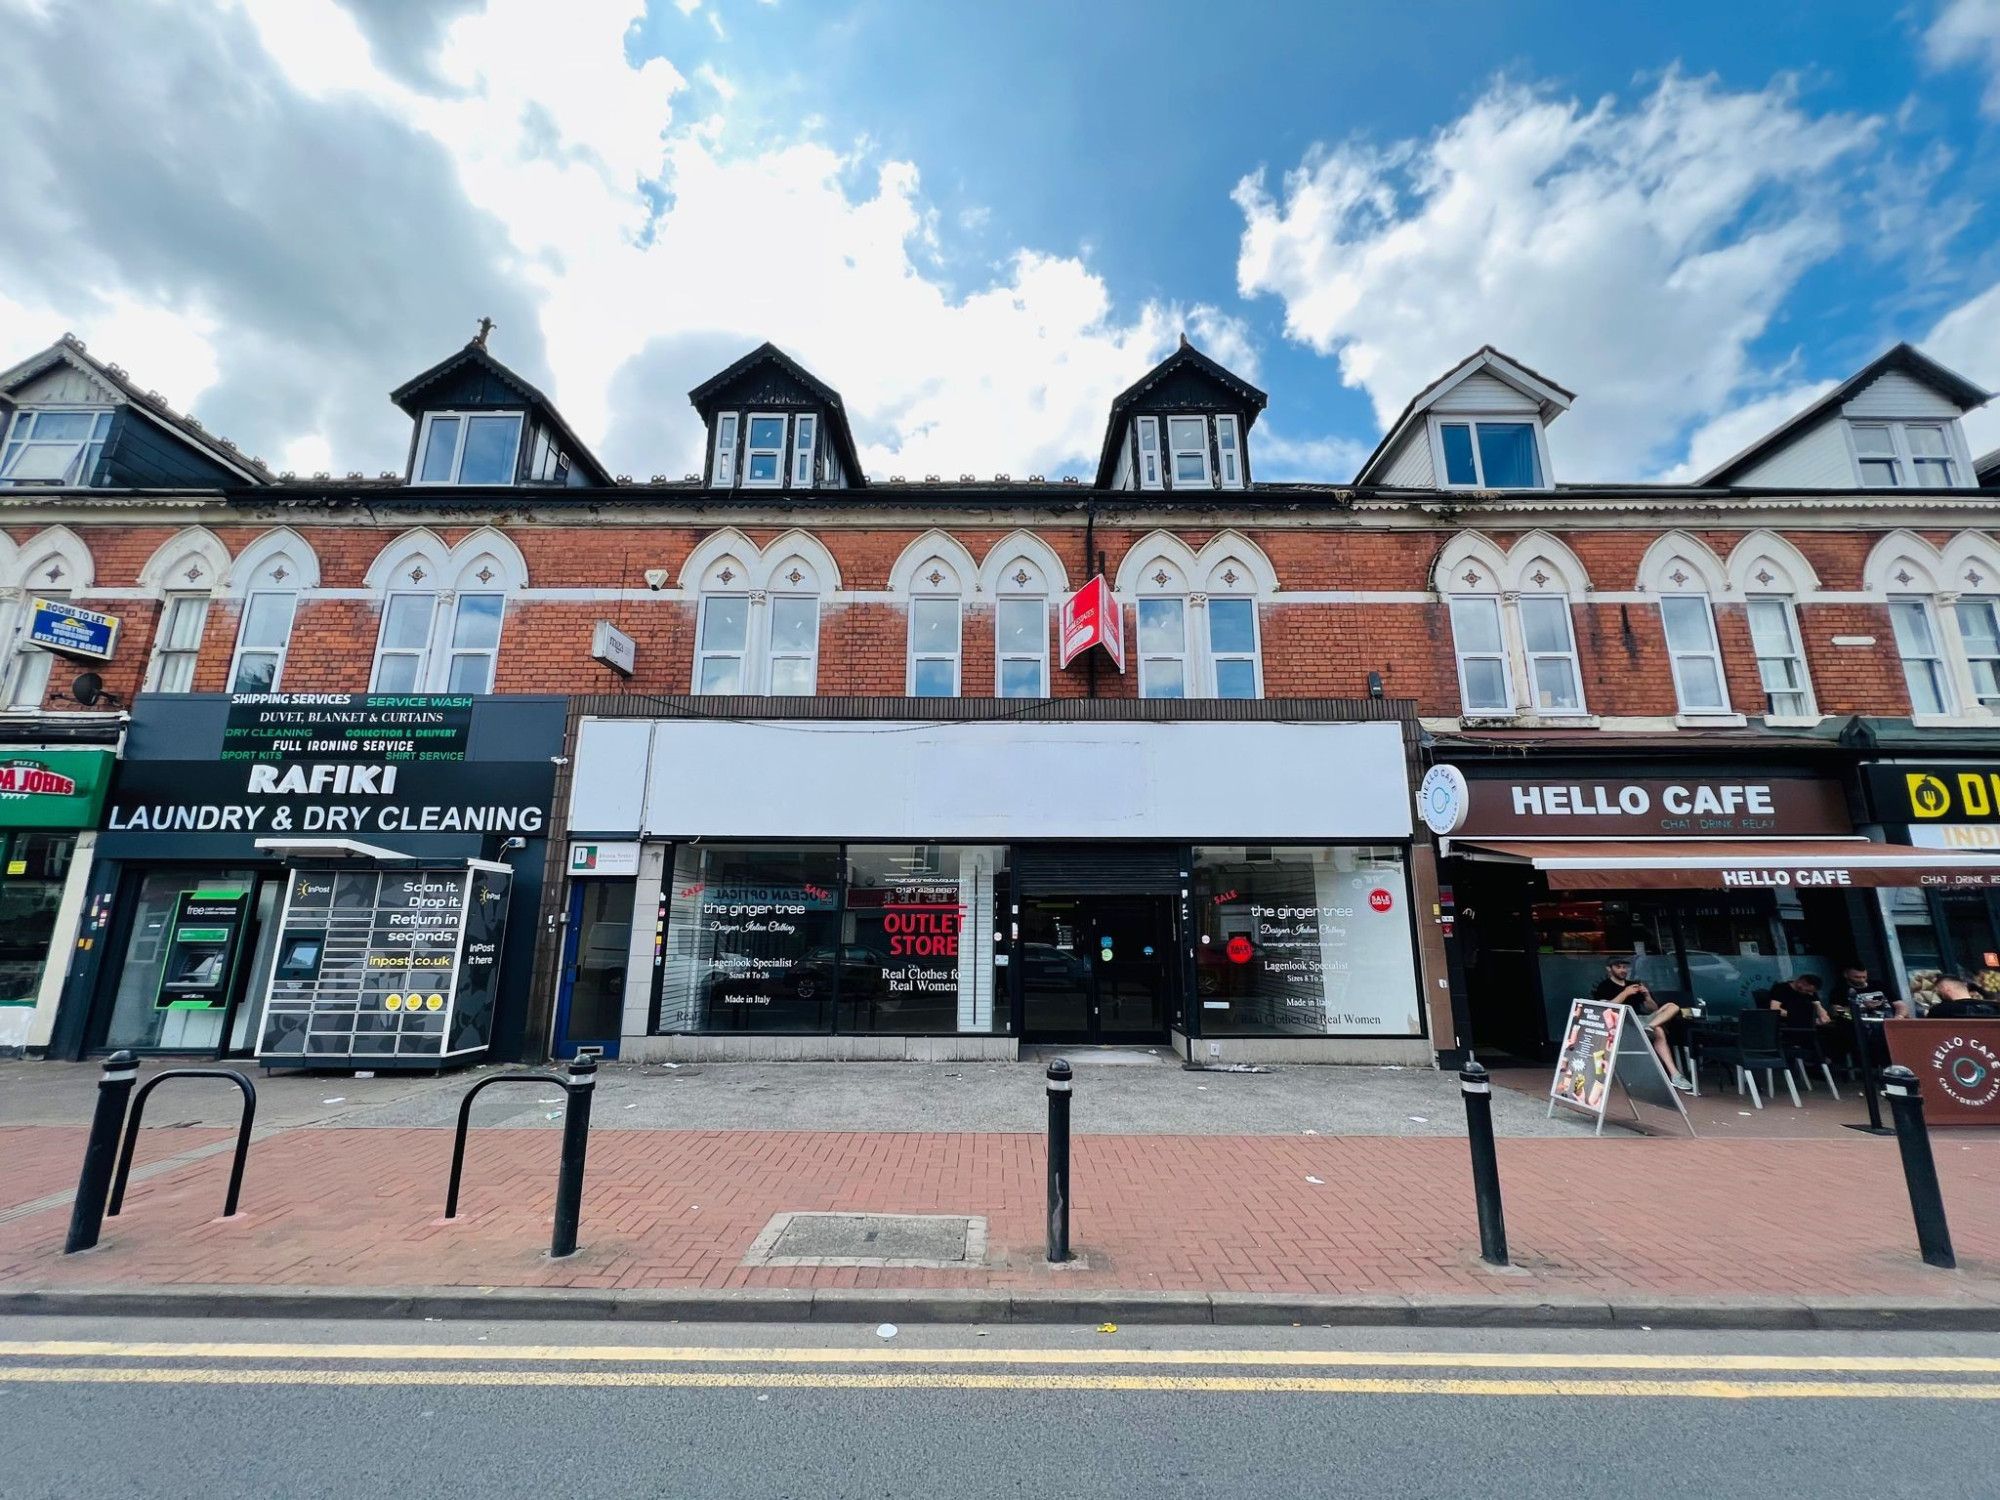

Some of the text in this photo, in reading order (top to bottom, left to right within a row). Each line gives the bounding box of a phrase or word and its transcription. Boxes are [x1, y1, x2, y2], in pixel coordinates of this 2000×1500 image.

[46, 603, 107, 624] ROOMS TO LET
[231, 694, 351, 704] SHIPPING SERVICES
[367, 697, 473, 707] SERVICE WASH
[260, 712, 444, 724] DUVET, BLANKET & CURTAINS
[225, 728, 313, 737] DRY CLEANING
[345, 728, 457, 737] COLLECTION & DELIVERY
[272, 740, 414, 751] FULL IRONING SERVICE
[221, 751, 283, 760] SPORT KITS
[385, 751, 465, 760] SHIRT SERVICE
[13, 760, 40, 768] PIZZA
[247, 764, 398, 794] RAFIKI
[1423, 769, 1439, 799] HELLO
[1511, 786, 1775, 815] HELLO CAFE
[108, 805, 543, 831] LAUNDRY & DRY CLEANING
[1661, 819, 1690, 829] CHAT
[1701, 819, 1733, 829] DRINK
[1722, 870, 1852, 886] HELLO CAFE
[1921, 875, 1947, 884] CHAT
[1955, 875, 1984, 884] DRINK
[403, 882, 459, 893] Scan it.
[680, 882, 705, 899] SALE
[408, 896, 461, 908] Drop it.
[1214, 889, 1239, 905] SALE
[1371, 895, 1391, 905] SALE
[186, 905, 205, 915] free
[704, 902, 806, 917] the ginger tree
[1251, 904, 1354, 919] the ginger tree
[390, 914, 458, 925] Return in
[884, 913, 966, 933] OUTLET
[709, 921, 795, 934] Designer Italian Clothing
[1260, 923, 1290, 937] Designer
[388, 931, 455, 942] seconds.
[469, 943, 495, 953] InPost
[890, 935, 958, 955] STORE
[369, 955, 450, 967] inpost.co.uk
[475, 956, 493, 965] here
[708, 957, 792, 970] Lagenlook Specialist
[1264, 960, 1349, 972] Lagenlook Specialist
[882, 968, 905, 979] Real
[908, 968, 947, 980] Clothes
[889, 980, 957, 991] Real Women
[724, 995, 772, 1006] Made in Italy
[1286, 998, 1306, 1007] Made
[1308, 998, 1315, 1007] in
[1320, 1013, 1341, 1025] Real
[1345, 1013, 1381, 1025] Women
[1933, 1036, 2000, 1069] HELLO CAFE
[1939, 1077, 1957, 1097] CHAT
[1959, 1097, 1985, 1106] DRINK
